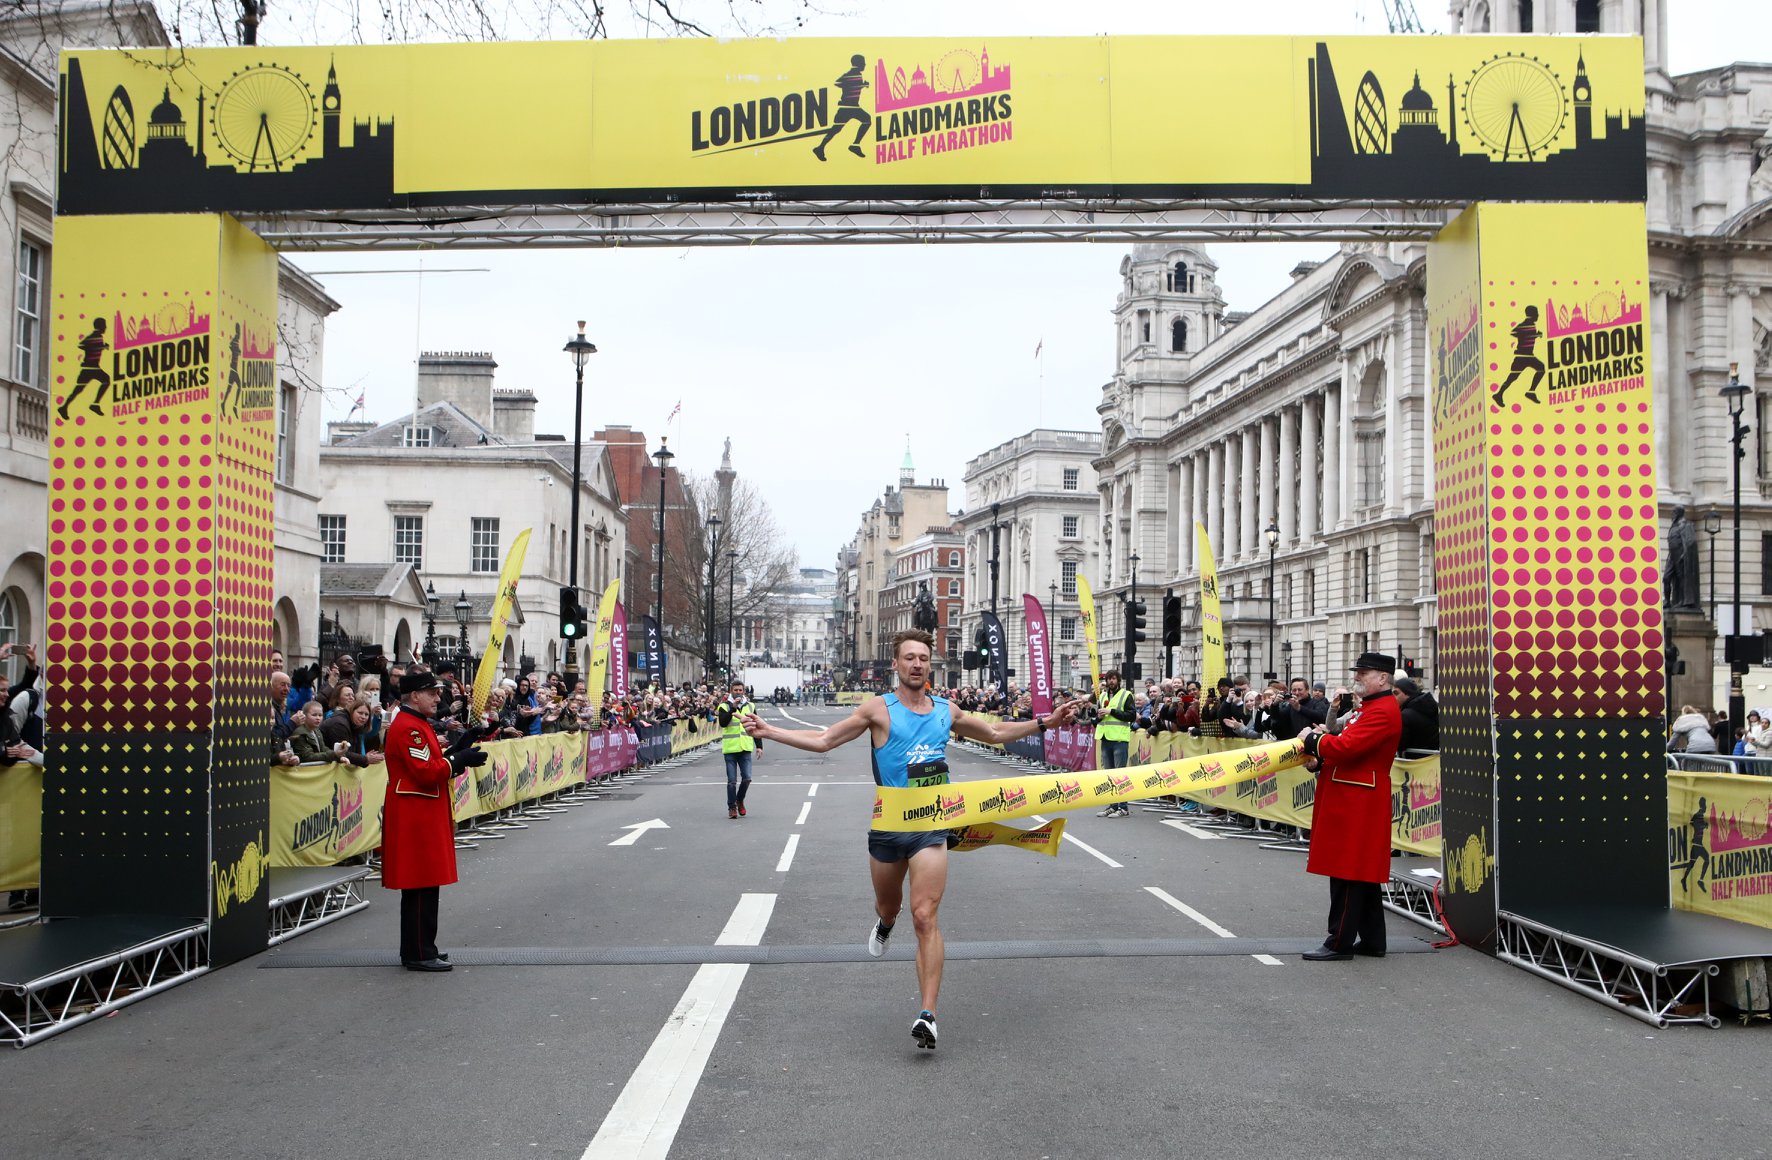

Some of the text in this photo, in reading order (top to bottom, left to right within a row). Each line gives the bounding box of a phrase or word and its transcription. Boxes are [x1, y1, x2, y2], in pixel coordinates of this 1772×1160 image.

[692, 88, 828, 151] LONDON
[876, 94, 1012, 142] LANDMARKS
[876, 121, 1013, 164] HALF MARATHON
[113, 334, 210, 382] LONDON
[1448, 323, 1478, 384] LONDON
[1547, 324, 1643, 370] LONDON
[113, 367, 209, 402] LANDMARKS
[242, 361, 274, 388] LONDON
[1548, 356, 1644, 390] LANDMARKS
[112, 388, 209, 418] HALF MARATHON
[242, 390, 273, 408] LANDMARKS
[1549, 376, 1644, 406] HALF MARATHON
[916, 775, 942, 787] 1470
[1040, 788, 1058, 804] LONDON
[1292, 778, 1315, 808] LONDON
[904, 804, 935, 820] LONDON
[943, 802, 966, 816] LANDMARKS
[979, 795, 1001, 812] LONDON
[292, 805, 330, 850] LONDON
[1712, 879, 1733, 901] HALF
